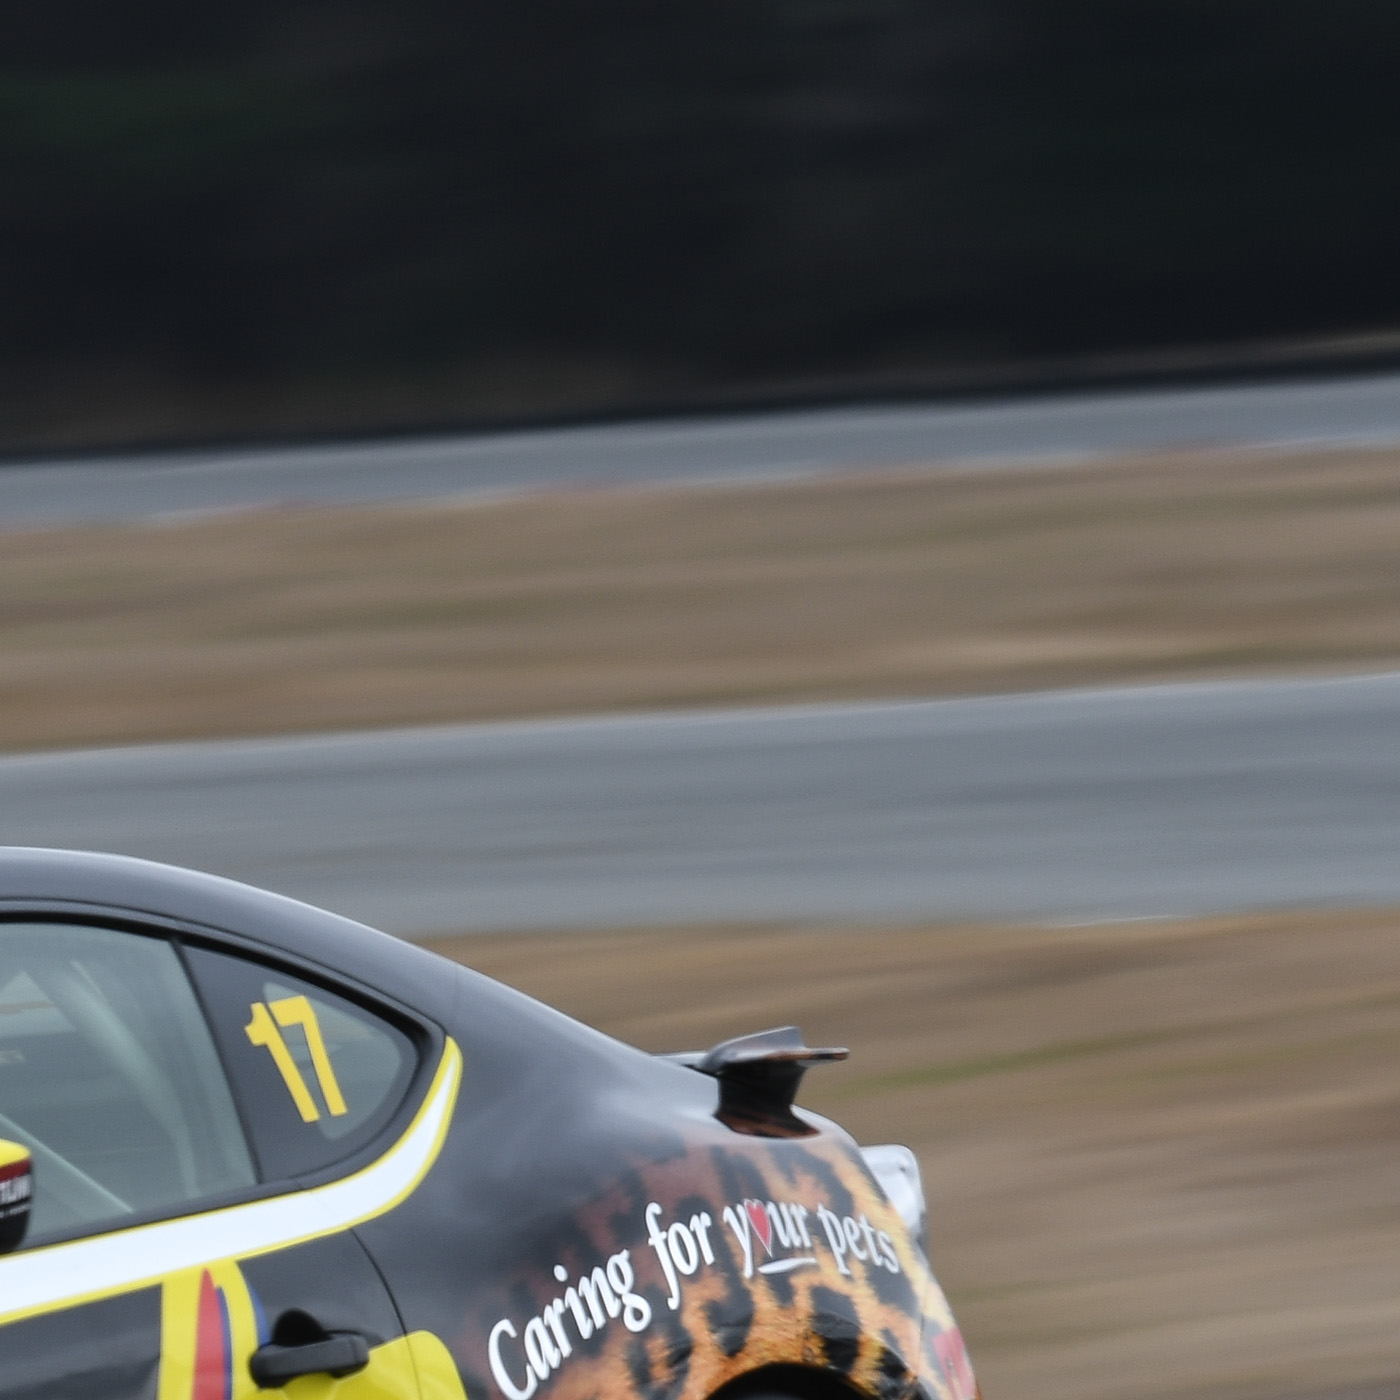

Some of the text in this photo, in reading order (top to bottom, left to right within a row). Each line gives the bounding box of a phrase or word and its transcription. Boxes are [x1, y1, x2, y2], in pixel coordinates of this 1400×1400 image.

[244, 995, 348, 1123] 17
[645, 1202, 713, 1311] for
[819, 1202, 901, 1275] pets
